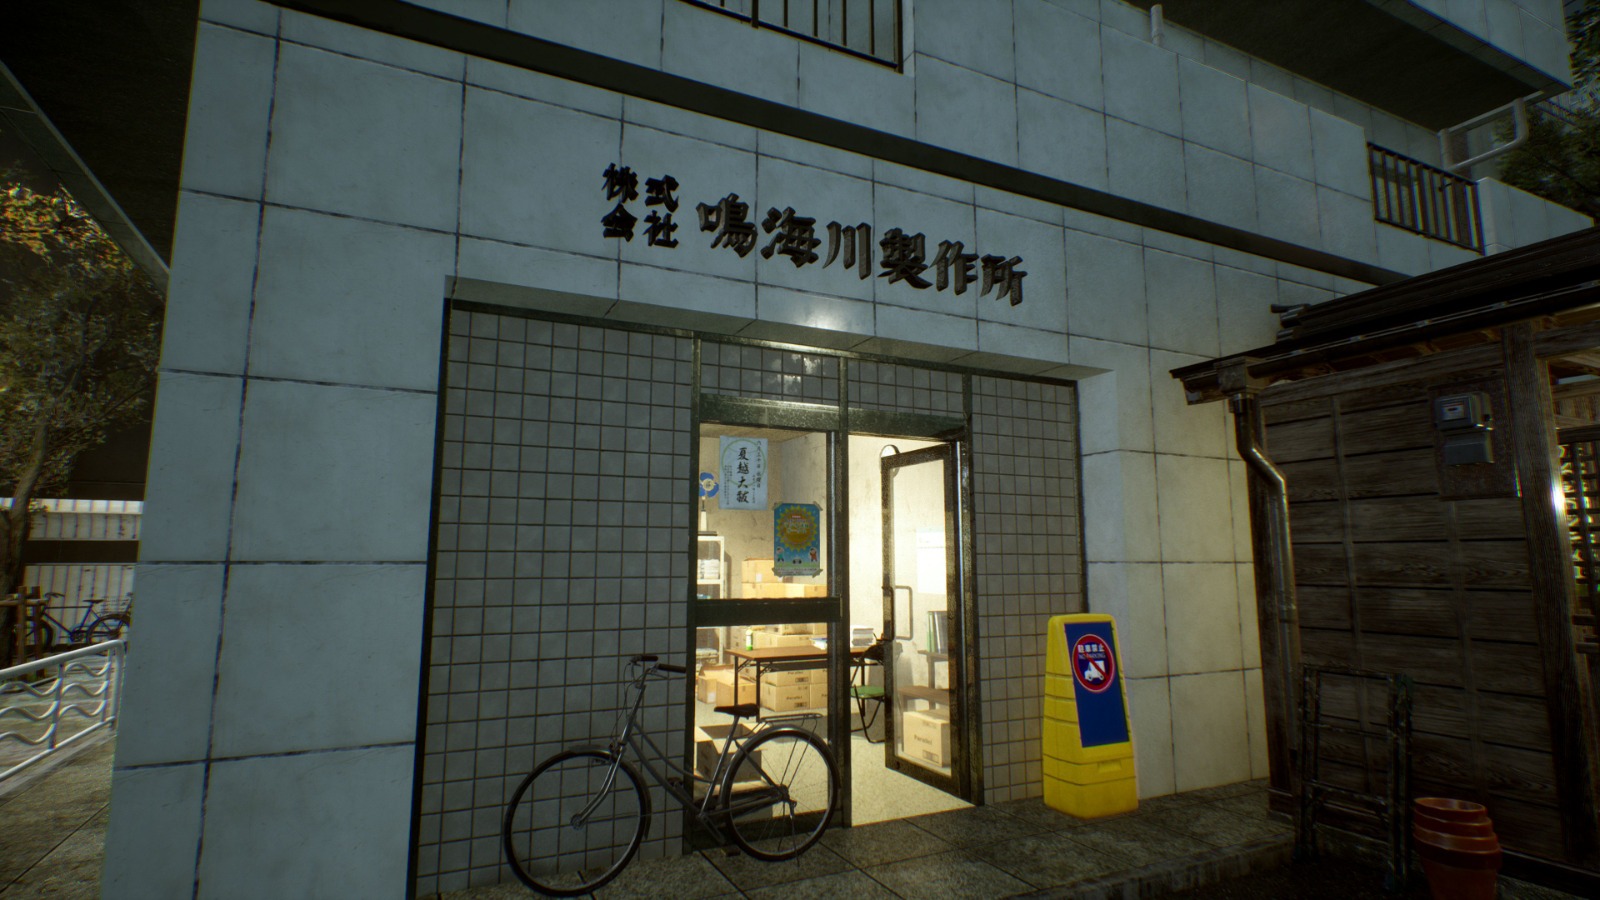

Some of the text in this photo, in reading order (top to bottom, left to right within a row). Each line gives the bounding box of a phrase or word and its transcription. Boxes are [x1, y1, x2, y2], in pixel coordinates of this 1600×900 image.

[601, 162, 679, 213] 株式
[600, 203, 679, 249] 会社
[696, 193, 1028, 306] 鳴海川製作所
